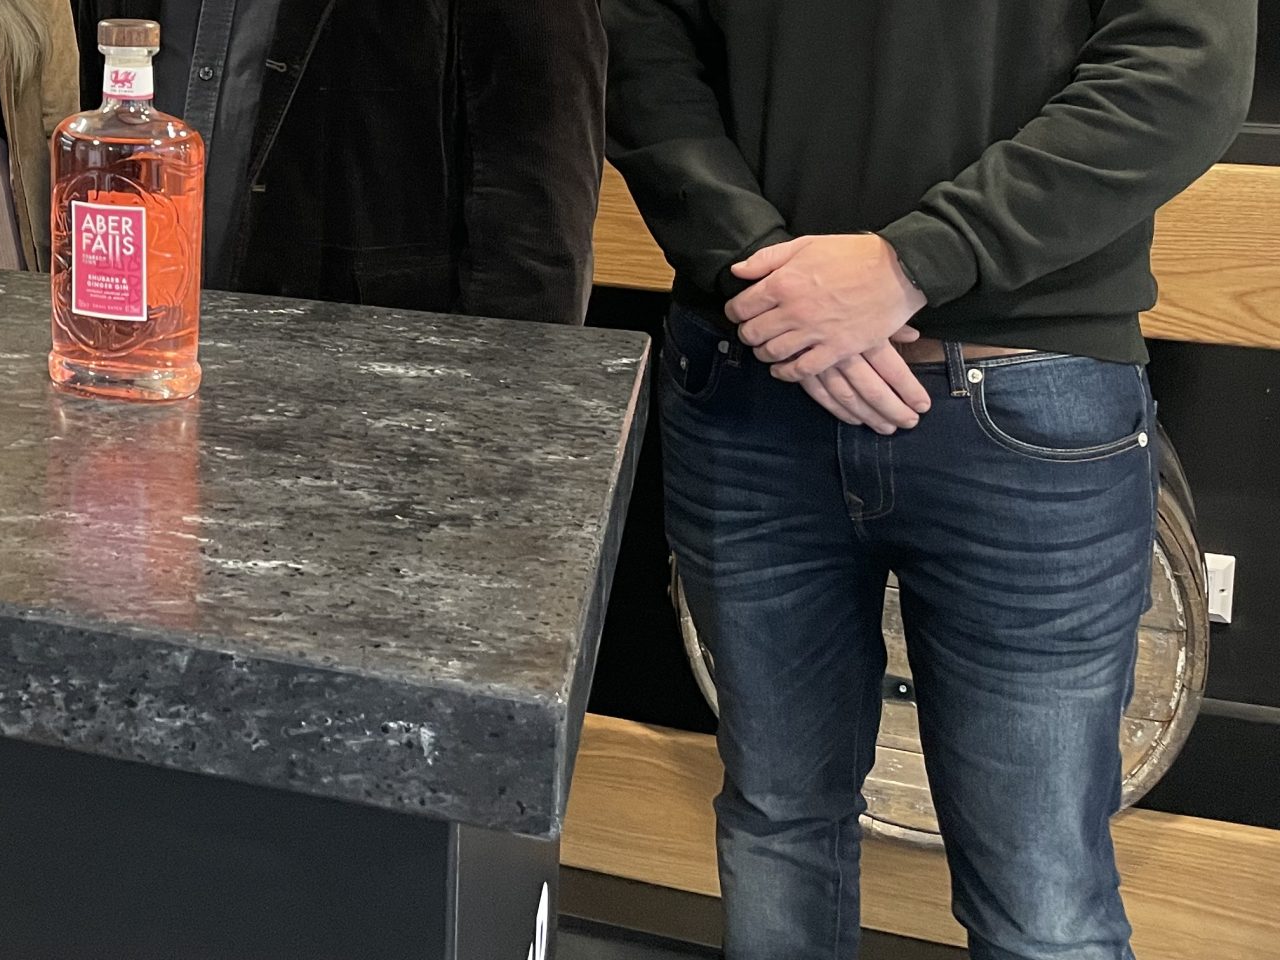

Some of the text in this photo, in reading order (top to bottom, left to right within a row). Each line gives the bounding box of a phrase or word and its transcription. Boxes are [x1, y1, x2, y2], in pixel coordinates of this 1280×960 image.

[81, 213, 135, 237] ABER
[87, 273, 120, 284] RHUBARB
[86, 280, 113, 290] GINGER
